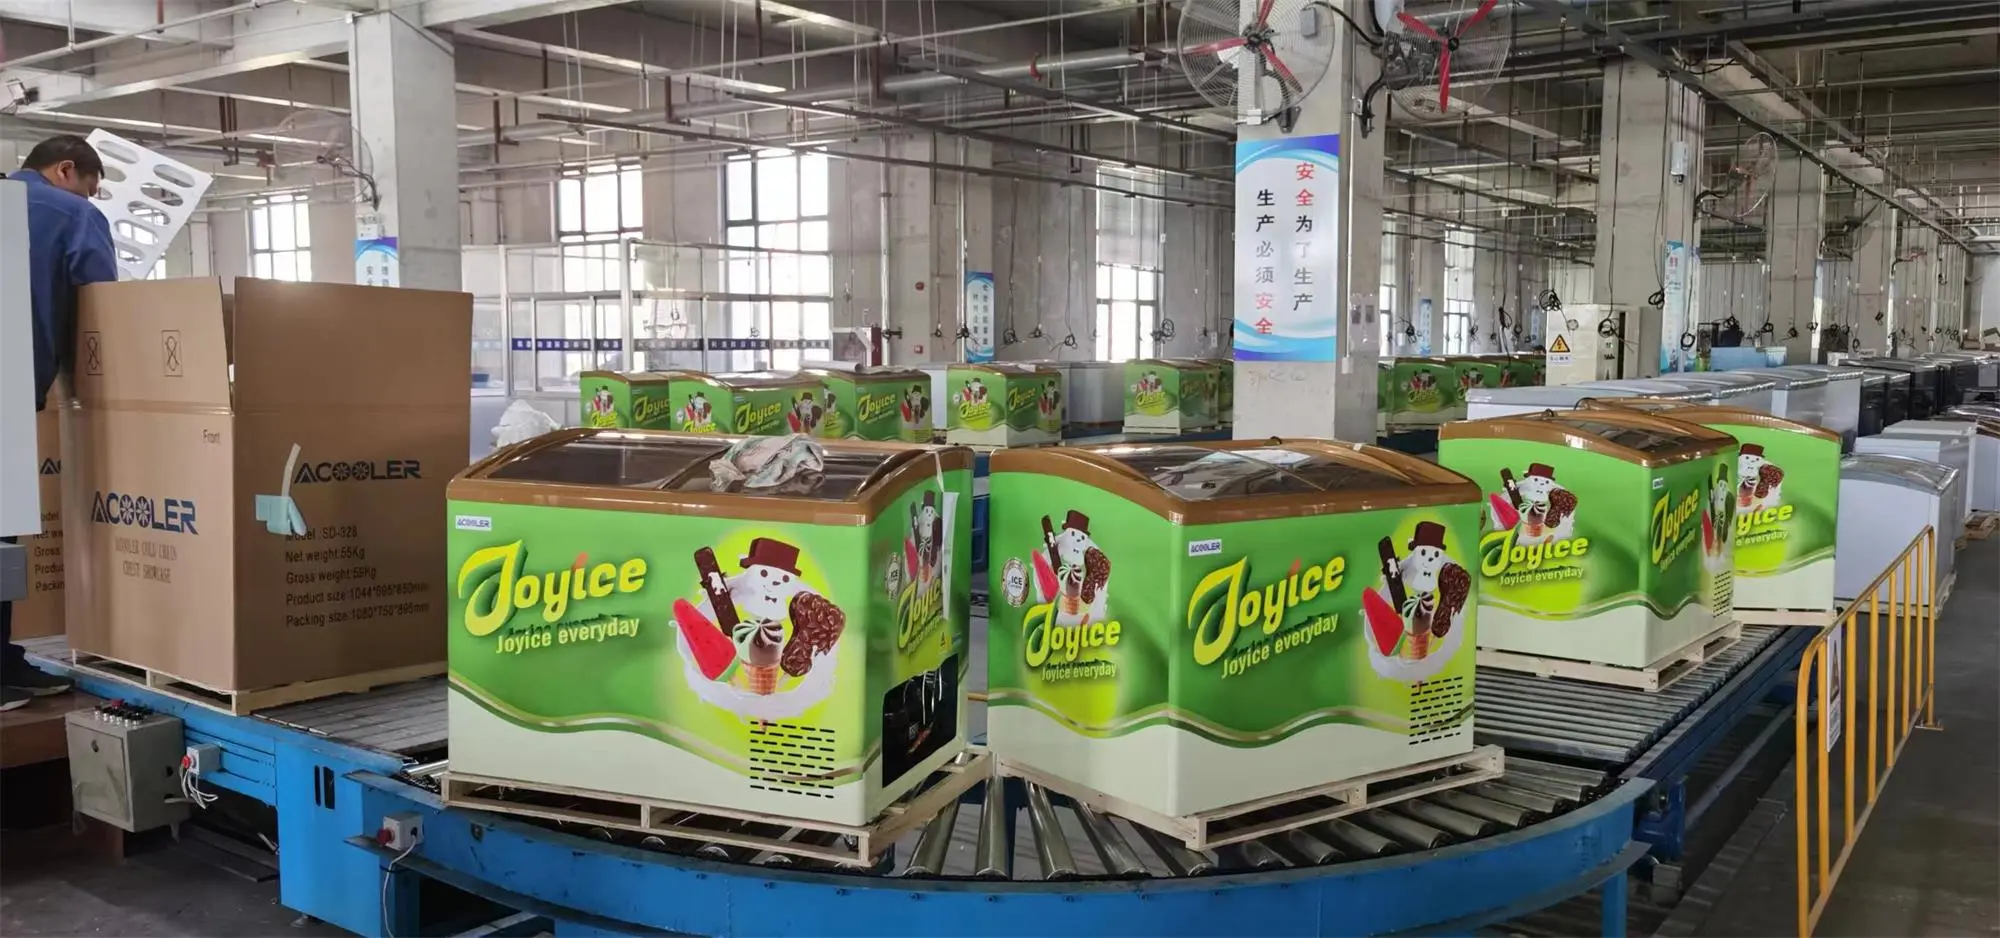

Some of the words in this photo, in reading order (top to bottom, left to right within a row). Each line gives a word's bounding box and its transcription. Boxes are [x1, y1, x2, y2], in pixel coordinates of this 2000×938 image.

[1293, 162, 1315, 311] 安全为了生产
[1255, 188, 1275, 335] 生产必须安全
[735, 402, 781, 433] Joyice
[203, 429, 221, 444] Front
[295, 460, 422, 483] ACOOLER
[41, 511, 59, 521] odel
[91, 490, 199, 535] ACOOLER
[1736, 504, 1793, 535] yice
[1651, 489, 1699, 564] Joyice
[286, 551, 303, 563] Net
[1191, 542, 1220, 552] ACOOLER
[1479, 528, 1588, 577] Joyice
[35, 580, 65, 592] Packin
[286, 571, 315, 585] Gross
[458, 539, 647, 637] Joyice
[1011, 576, 1023, 586] ICE
[1500, 572, 1532, 586] Joyice
[1535, 566, 1584, 581] everyday
[286, 591, 325, 606] Product
[1188, 556, 1345, 666] Joyice
[286, 612, 326, 628] Packing
[496, 631, 552, 654] Joyice
[558, 617, 640, 645] everyday
[1023, 602, 1121, 667] Joyice
[1222, 643, 1270, 679] Joyice
[1275, 613, 1339, 654] everyday
[1042, 665, 1071, 681] Joyice
[1073, 661, 1117, 679] everyday
